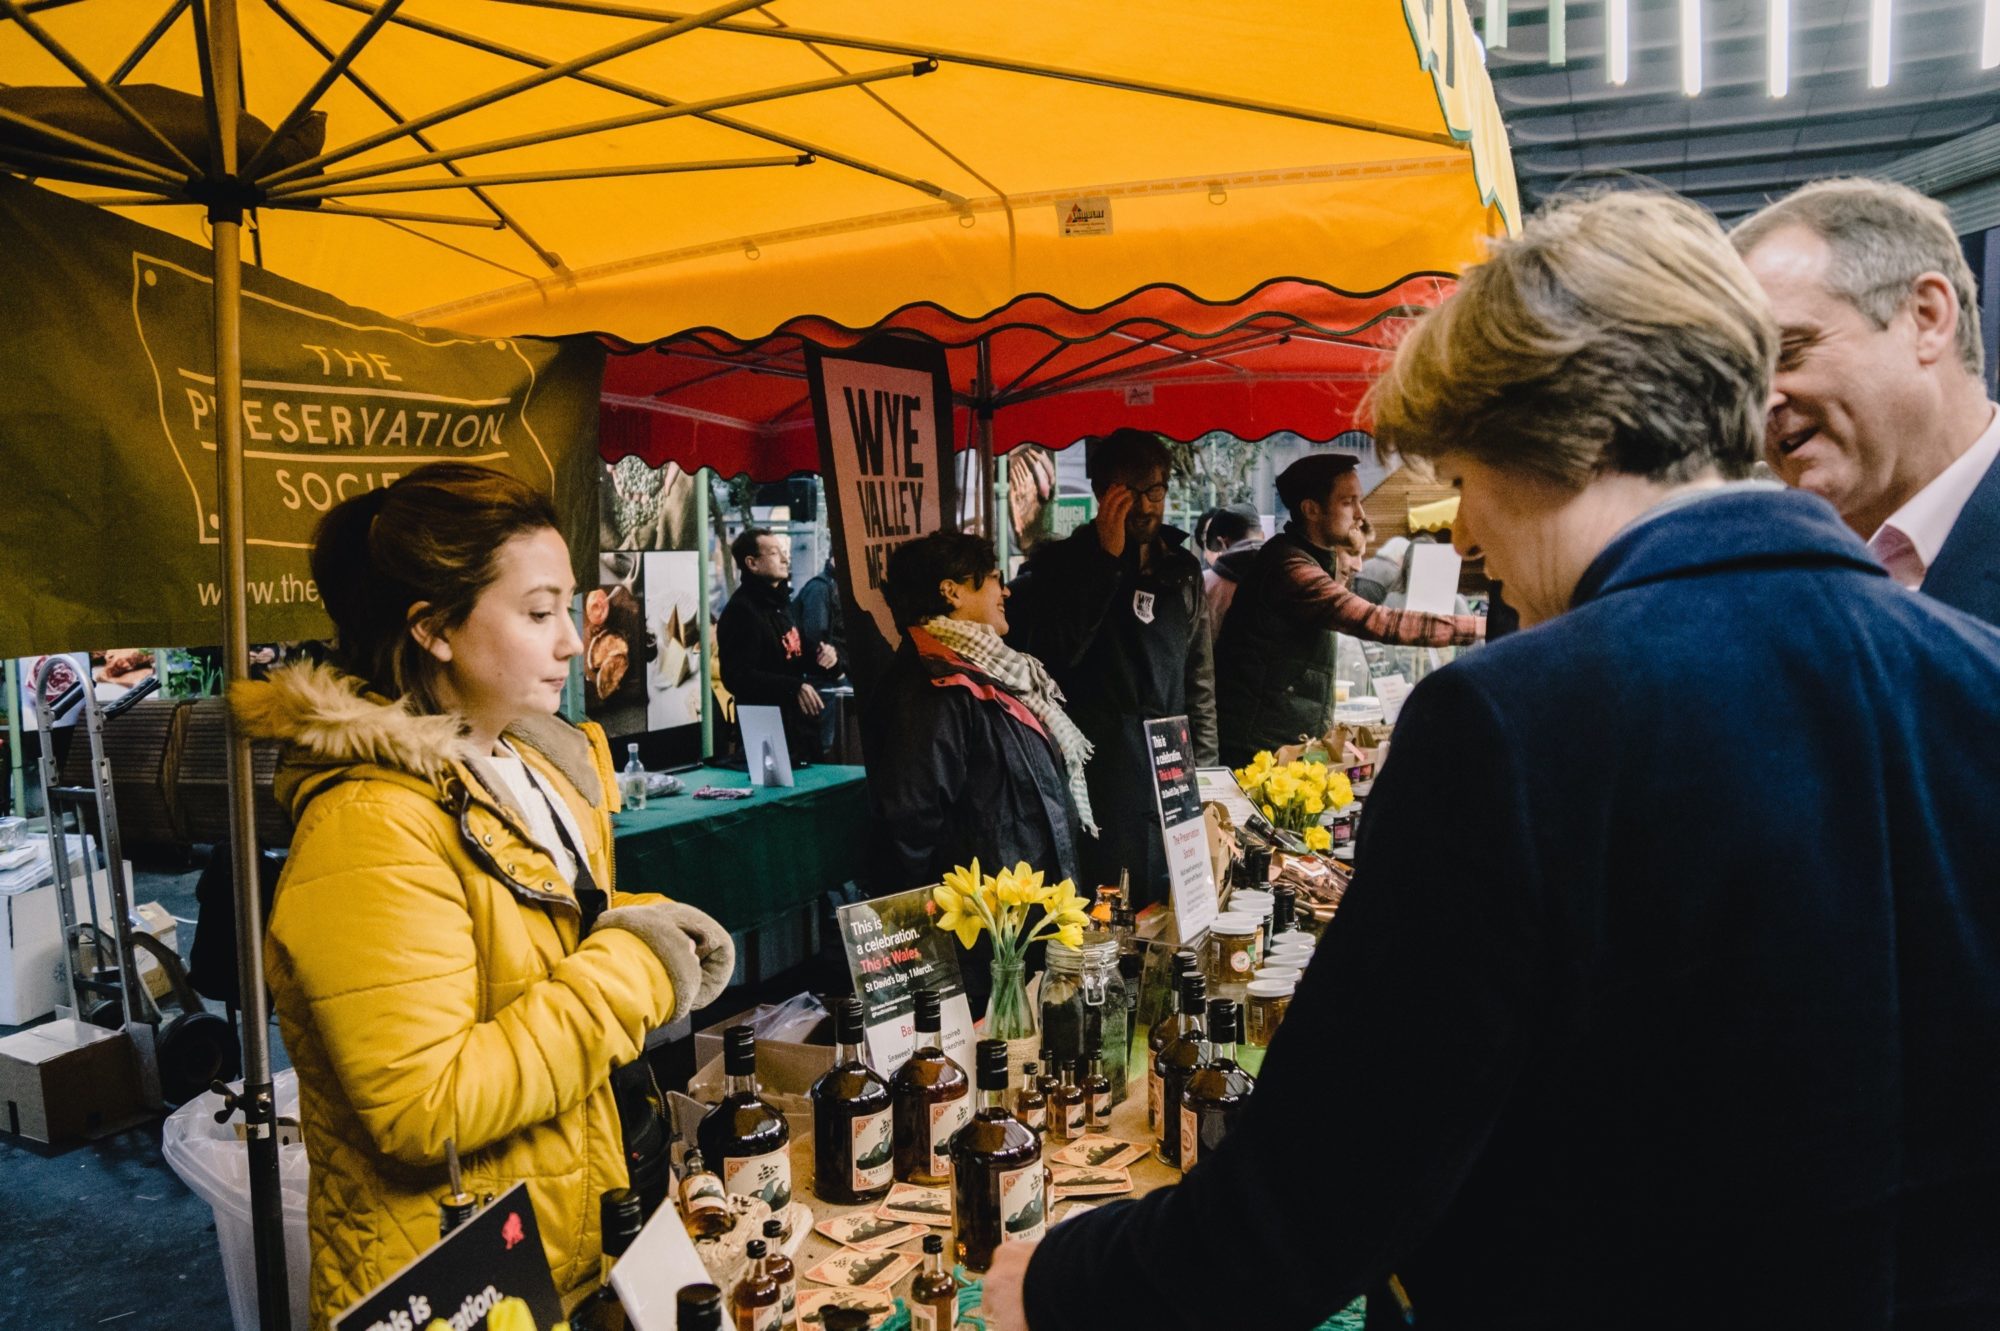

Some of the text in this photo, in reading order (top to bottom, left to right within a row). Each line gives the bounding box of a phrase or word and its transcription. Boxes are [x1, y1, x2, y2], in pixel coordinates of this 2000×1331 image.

[302, 344, 403, 382] THE
[843, 387, 924, 478] WYE
[857, 481, 923, 538] VALLEY
[198, 573, 325, 609] ww.the
[851, 917, 883, 936] This is
[856, 928, 920, 955] a celebration.
[860, 957, 881, 973] This
[883, 955, 891, 967] is
[865, 982, 874, 992] St
[887, 1028, 961, 1063] Seaweed nspired
[942, 1039, 966, 1052] rokeshire
[365, 1294, 433, 1331] is is
[448, 1285, 504, 1331] ation.
